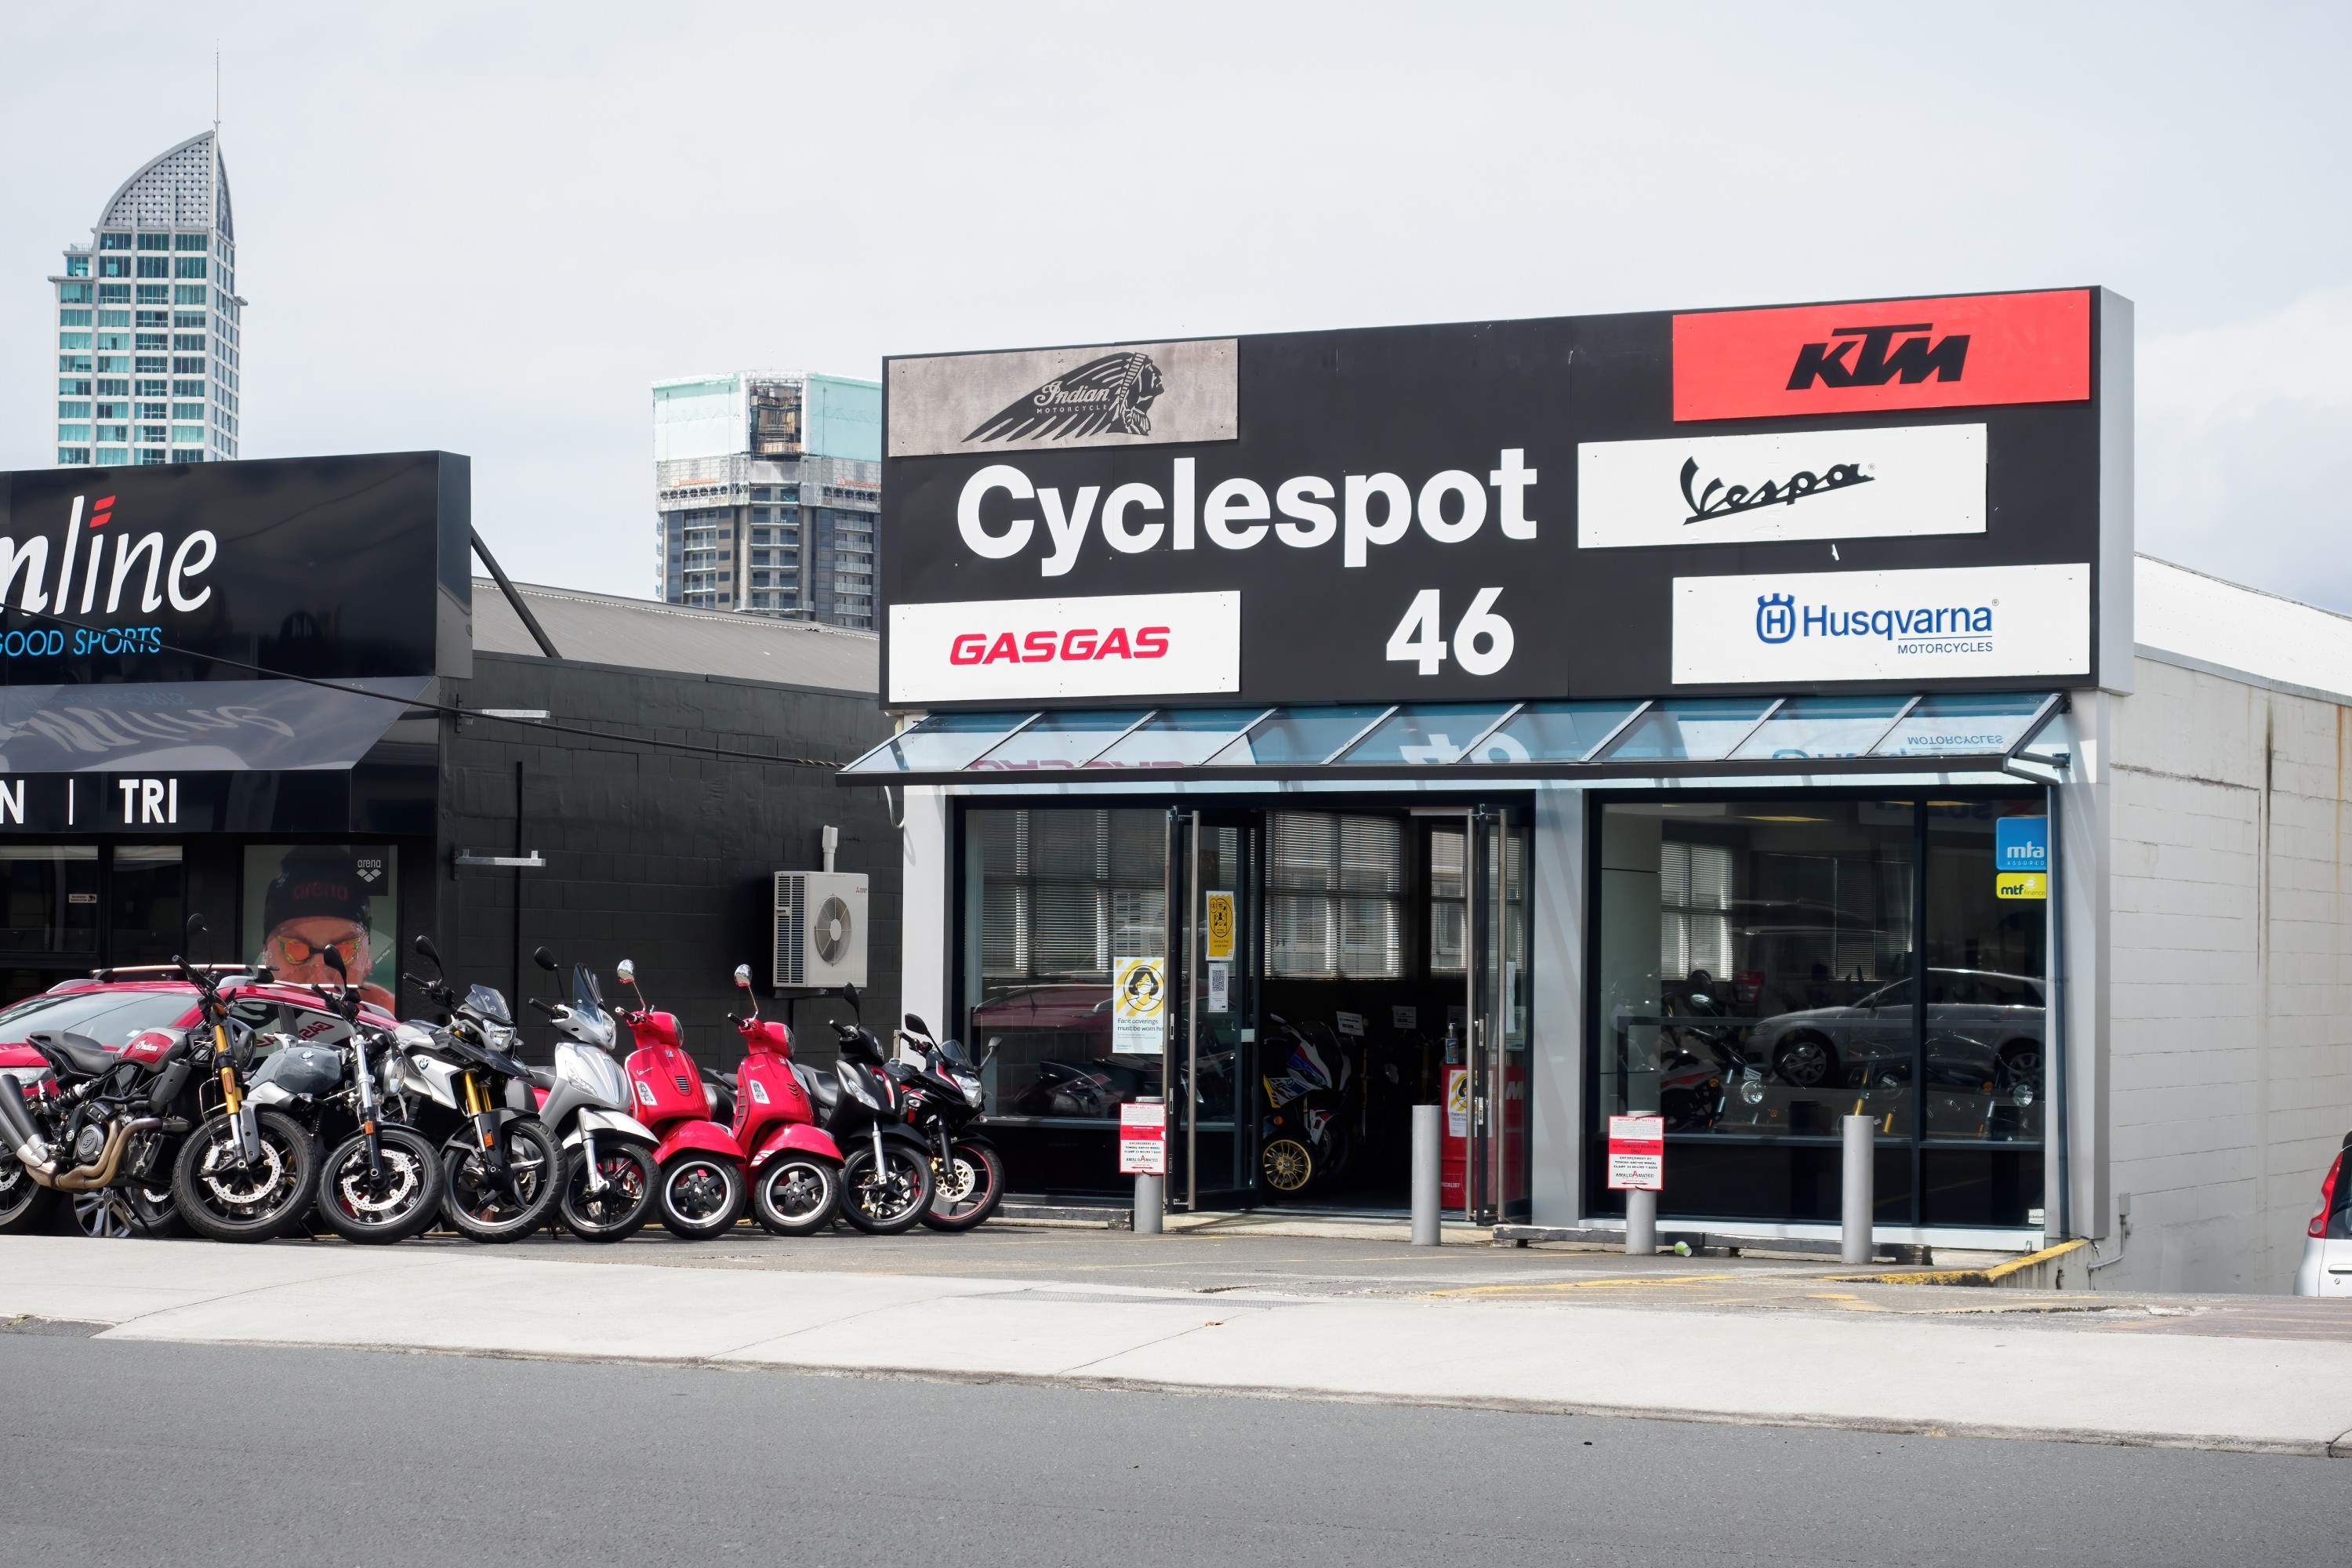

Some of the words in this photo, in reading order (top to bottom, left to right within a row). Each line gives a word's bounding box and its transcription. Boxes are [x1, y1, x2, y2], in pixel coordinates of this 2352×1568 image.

[1785, 322, 1971, 391] KTM
[1034, 381, 1109, 406] Indian
[1036, 405, 1107, 414] MOTORCYCLE
[1679, 456, 1876, 526] Vespa
[957, 448, 1537, 577] Cyclespot
[1385, 586, 1515, 676] 46
[1803, 604, 1993, 641] Husqvarna
[0, 629, 65, 657] OOD
[73, 626, 162, 655] SPORTS
[949, 626, 1171, 666] GASGAS
[1897, 641, 1993, 655] MOTORCYCLES
[118, 778, 177, 824] TRI
[358, 858, 381, 868] arena
[2006, 840, 2045, 858] mta
[292, 880, 348, 901] arena
[2001, 884, 2024, 895] mtf
[136, 1040, 158, 1051] Indian
